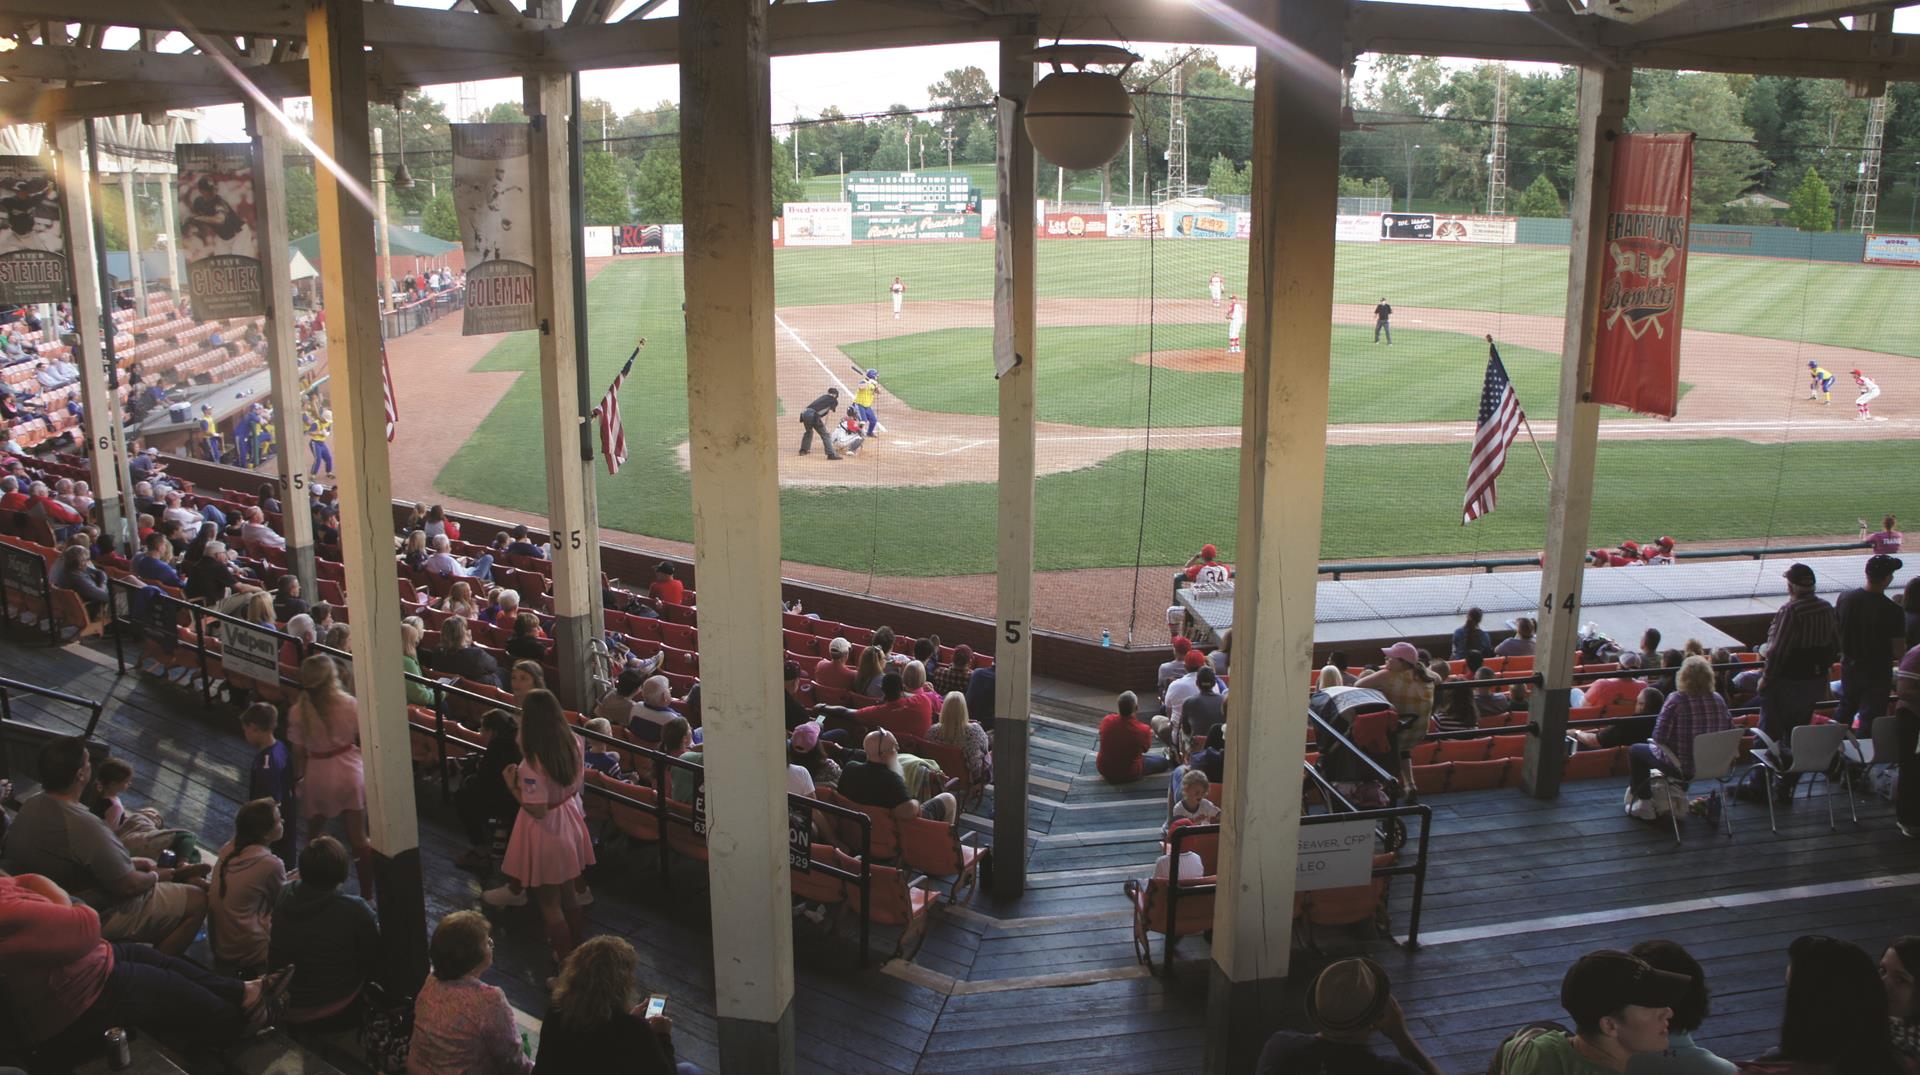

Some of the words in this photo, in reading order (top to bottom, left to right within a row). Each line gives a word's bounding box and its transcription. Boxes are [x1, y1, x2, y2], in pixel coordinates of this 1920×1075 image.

[788, 206, 848, 214] Budweiser
[867, 222, 917, 238] Rockford
[1606, 212, 1685, 250] CHAMPIONS
[0, 261, 62, 283] STETTER
[467, 274, 535, 309] COLEMAN
[1602, 280, 1674, 310] Bombers
[99, 436, 109, 450] 6
[294, 473, 304, 490] 5
[553, 531, 562, 550] 5
[571, 530, 581, 549] 5
[1206, 570, 1224, 582] 34
[1544, 593, 1552, 614] 4
[1562, 593, 1575, 615] 4
[1006, 620, 1021, 644] 5
[263, 754, 270, 769] 1
